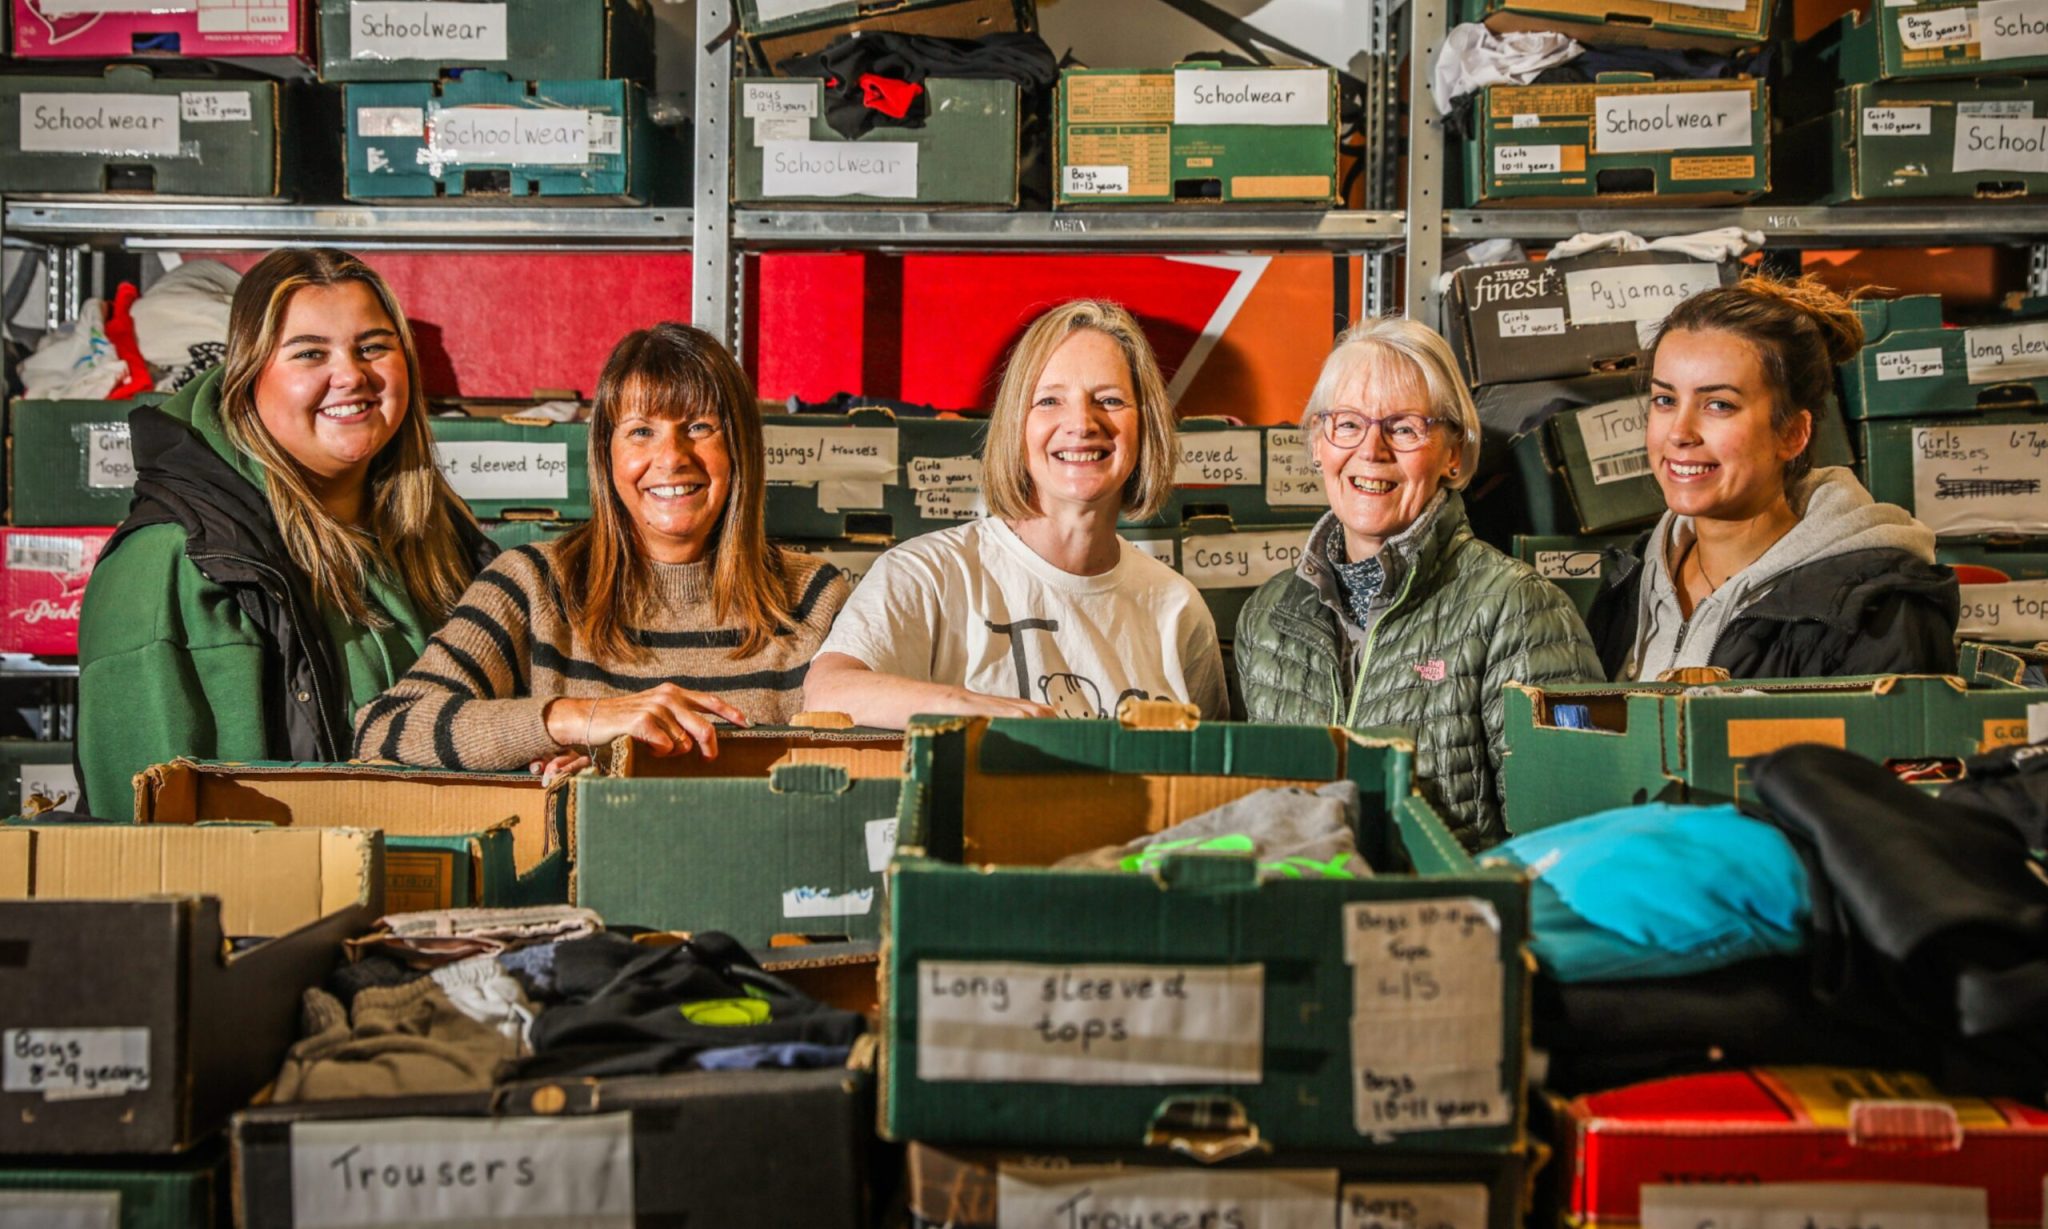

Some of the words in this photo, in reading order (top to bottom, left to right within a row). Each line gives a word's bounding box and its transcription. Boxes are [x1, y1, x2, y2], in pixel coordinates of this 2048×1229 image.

[360, 14, 488, 41] Schoolwear
[1907, 16, 1933, 30] Boys
[1935, 24, 1966, 40] years
[1994, 13, 2048, 36] Scho
[750, 88, 781, 104] Boys
[1193, 85, 1296, 105] Schoolwear
[34, 106, 165, 131] Schoolwear
[1606, 104, 1728, 134] Schoolwear
[1867, 110, 1896, 120] Girls
[444, 117, 586, 146] Schoolwear
[1968, 124, 2048, 152] School
[775, 152, 901, 175] Schoolwear
[1500, 149, 1527, 158] Girls
[1071, 168, 1097, 181] Boys
[1528, 163, 1555, 172] years
[1072, 181, 1095, 191] 11-12
[1095, 182, 1123, 194] years
[1493, 268, 1530, 281] TESCO
[1470, 273, 1549, 311] finest
[1591, 280, 1690, 310] Pyjamas
[1502, 312, 1530, 324] Girls
[1510, 325, 1527, 335] 6-7
[1531, 324, 1559, 336] years
[1880, 354, 1912, 367] Girls
[1971, 337, 2005, 366] long
[2011, 333, 2048, 356] sleev
[99, 434, 132, 451] Girl
[764, 438, 824, 465] ggings/
[1272, 434, 1305, 447] GIRL
[1918, 430, 1960, 450] Girls
[2034, 438, 2048, 458] ye
[471, 454, 527, 474] sleeved
[536, 453, 567, 477] tops
[914, 461, 941, 471] Girls
[946, 474, 972, 485] years
[927, 492, 951, 504] Girls
[952, 510, 979, 519] years
[1195, 548, 1249, 576] Cosy
[1262, 540, 1300, 567] top
[1960, 602, 2000, 625] osy
[2012, 594, 2048, 619] top
[932, 968, 1011, 1011] Long
[1041, 971, 1190, 1001] sleeved
[14, 1030, 82, 1065] Boys
[1035, 1018, 1130, 1054] tops
[29, 1064, 79, 1085] 8-9
[83, 1065, 149, 1088] years
[330, 1144, 536, 1191] Trousers
